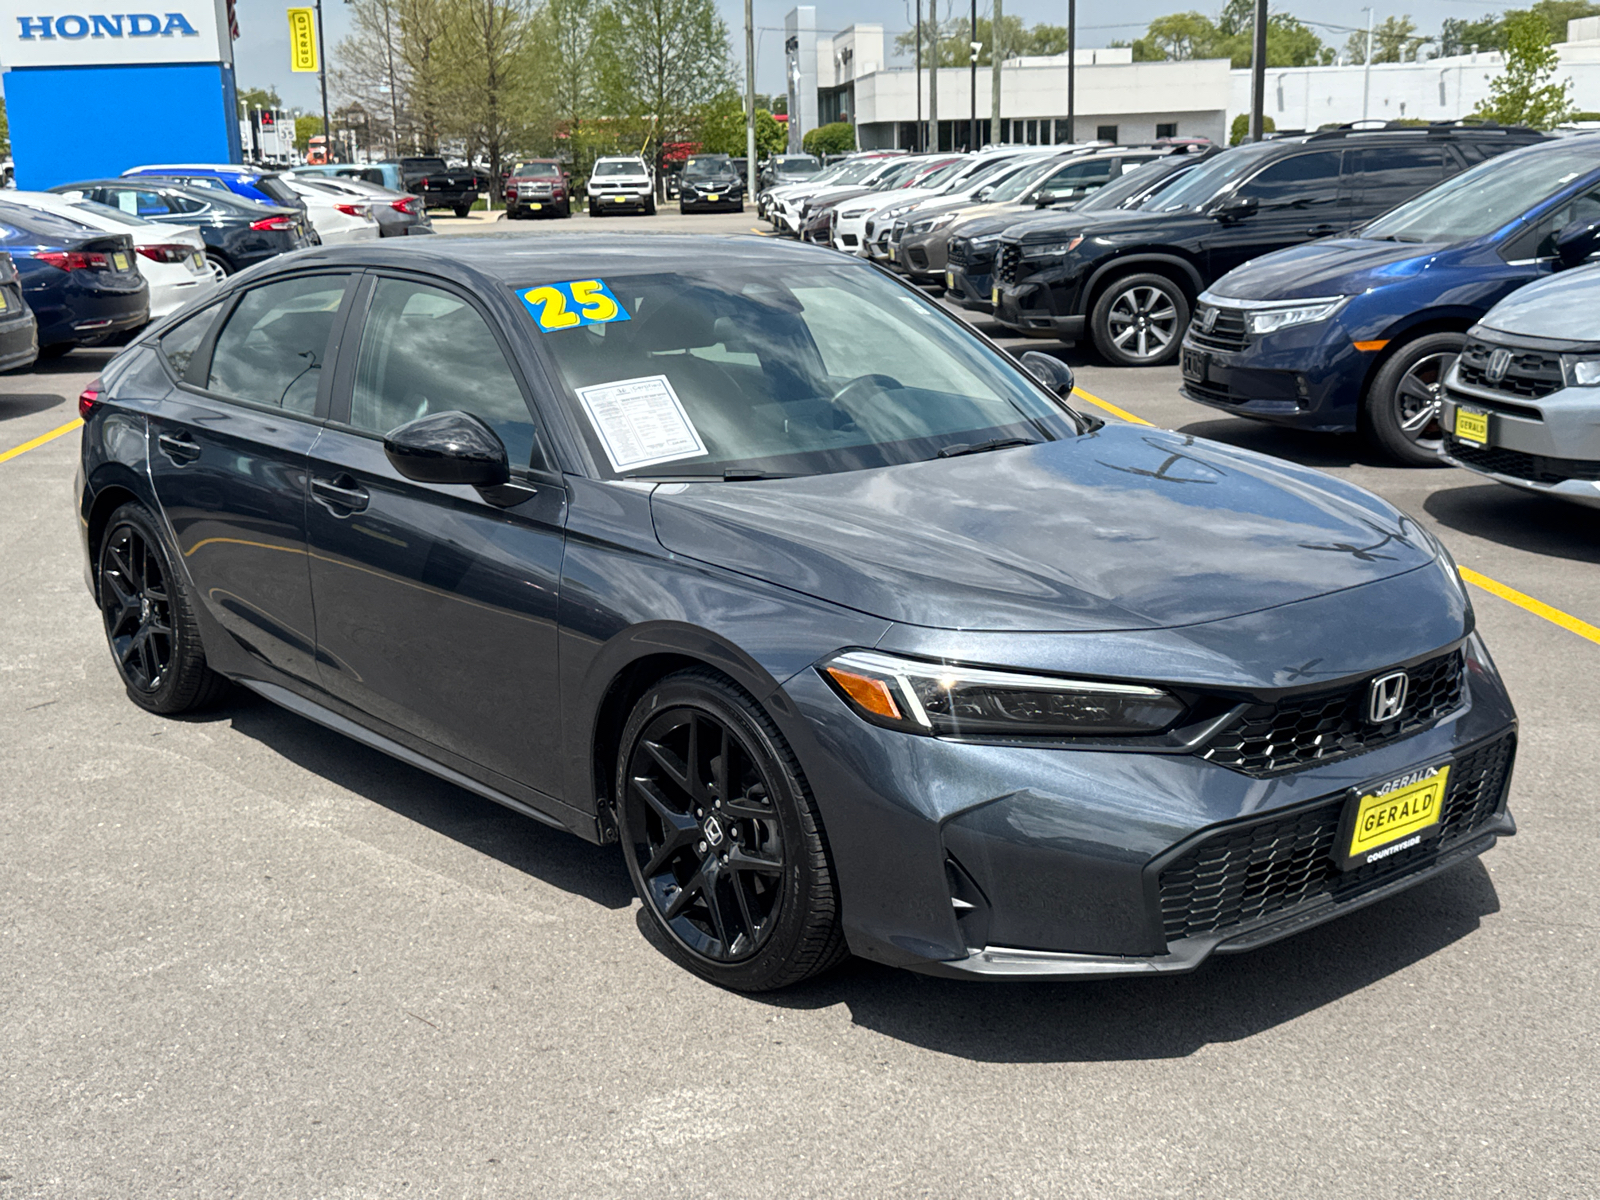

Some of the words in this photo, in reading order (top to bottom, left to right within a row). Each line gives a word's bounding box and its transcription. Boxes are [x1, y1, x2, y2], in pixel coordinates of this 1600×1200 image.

[16, 13, 200, 40] HONDA
[298, 16, 309, 64] GERALD
[281, 130, 294, 140] 35
[524, 280, 618, 328] 25
[1460, 419, 1485, 434] GERALD
[1380, 766, 1435, 795] GERALD
[1364, 793, 1432, 832] GERALD
[1366, 836, 1421, 863] COUNTRYSIDE
